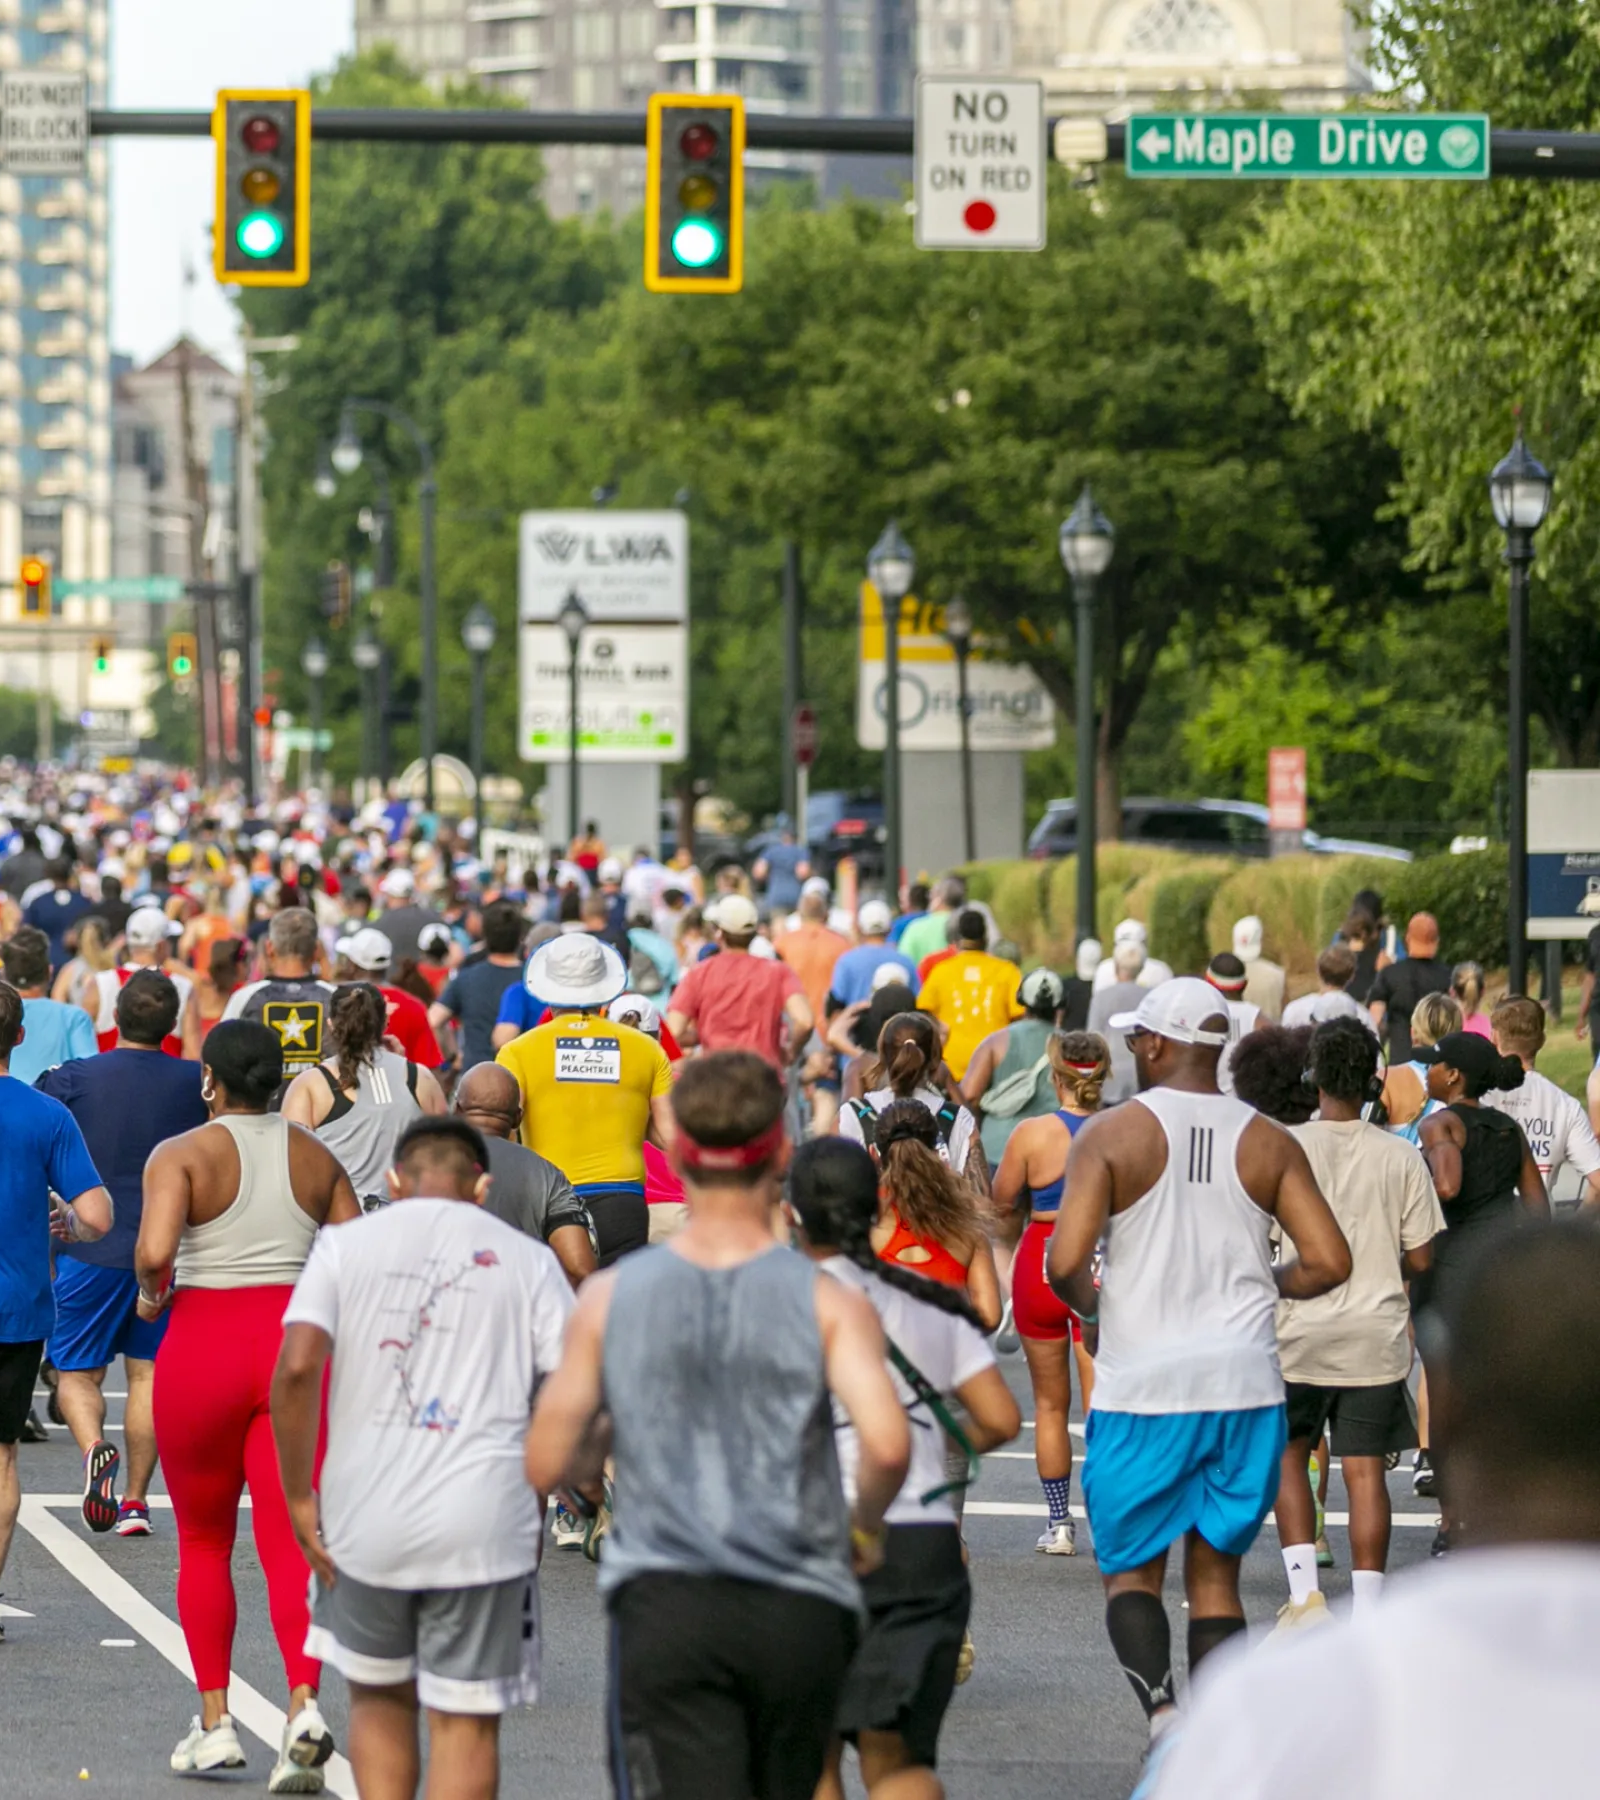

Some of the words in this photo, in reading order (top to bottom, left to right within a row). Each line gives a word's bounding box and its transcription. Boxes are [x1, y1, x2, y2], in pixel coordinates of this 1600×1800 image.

[4, 83, 34, 107] DO
[40, 83, 81, 107] NOT
[952, 90, 1009, 123] NO
[3, 117, 78, 139] BLOCK
[947, 132, 1017, 157] TURN
[1173, 118, 1296, 175] Maple
[1318, 117, 1429, 166] Drive
[929, 166, 966, 191] ON
[981, 166, 1032, 192] RED
[585, 532, 675, 566] LWA
[561, 1053, 577, 1062] MY
[583, 1050, 605, 1063] 25
[560, 1064, 614, 1075] PEACHTREE
[1524, 1117, 1555, 1139] YOU,
